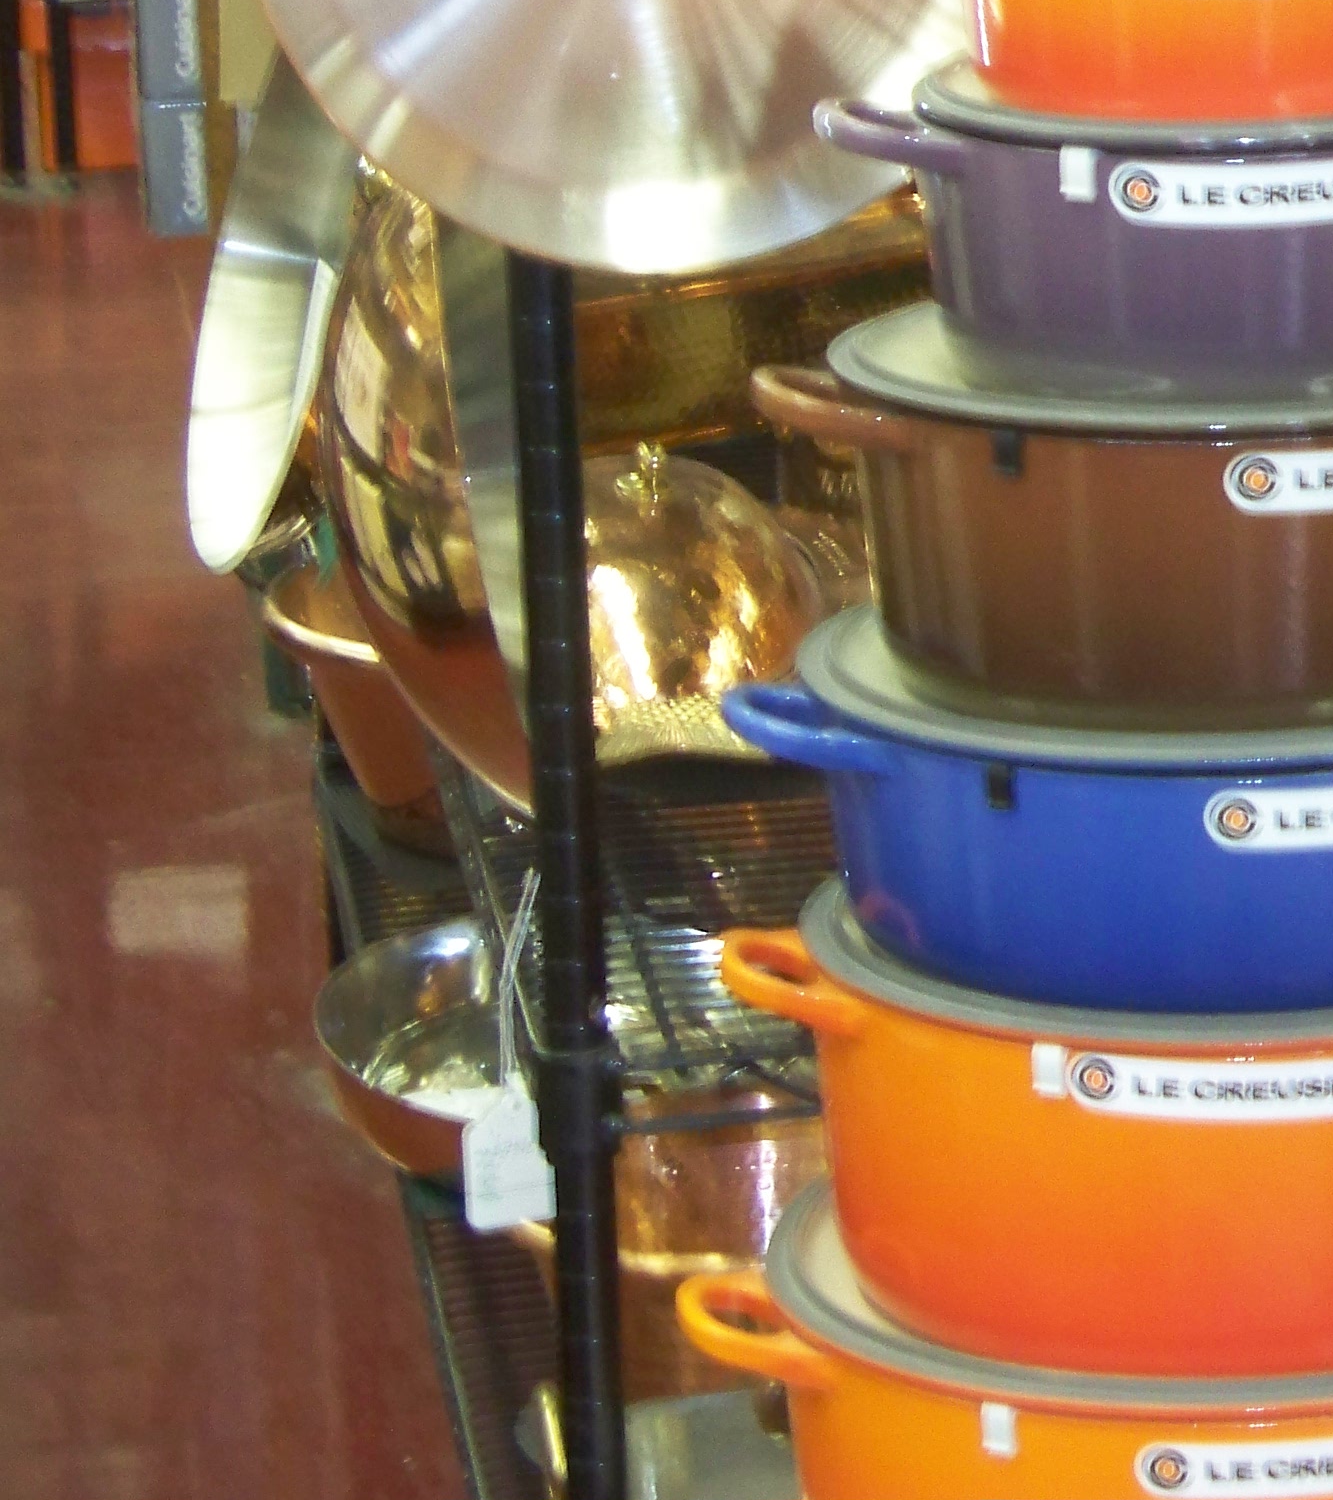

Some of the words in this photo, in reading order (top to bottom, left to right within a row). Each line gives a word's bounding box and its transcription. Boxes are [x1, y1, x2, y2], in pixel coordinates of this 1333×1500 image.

[181, 112, 206, 216] Cuisinart
[1178, 183, 1225, 206] LE
[1274, 808, 1323, 830] LE
[1132, 1074, 1179, 1099] LE
[1205, 1458, 1254, 1483] LE
